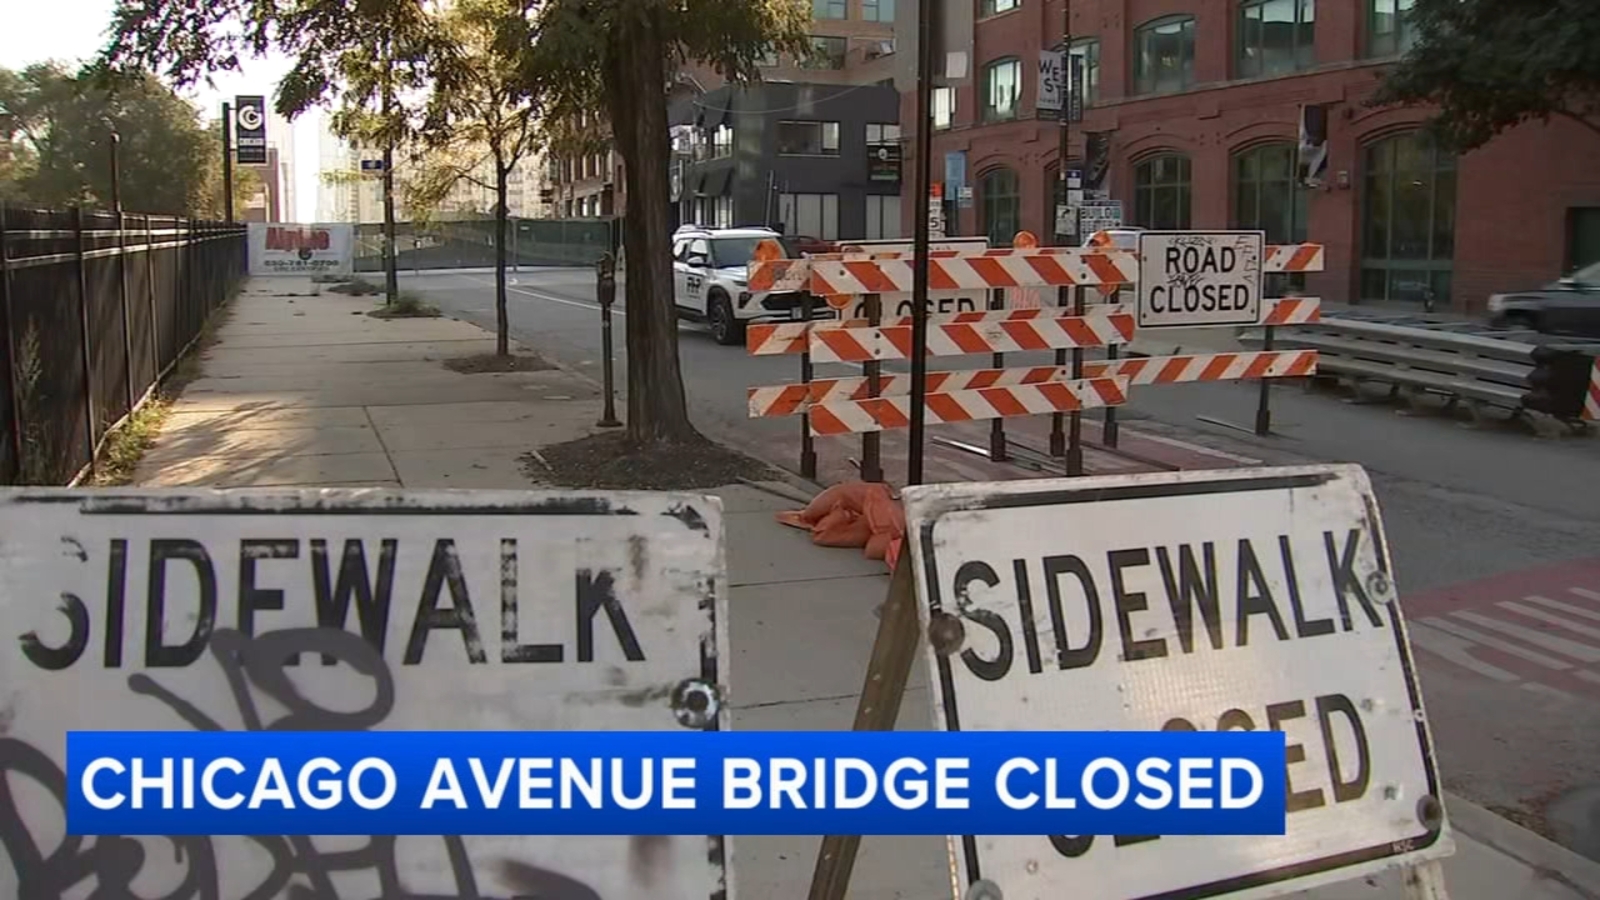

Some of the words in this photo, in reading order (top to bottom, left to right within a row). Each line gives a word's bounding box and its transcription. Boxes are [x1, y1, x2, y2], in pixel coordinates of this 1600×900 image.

[1151, 285, 1249, 313] CLOSED
[1166, 247, 1235, 273] ROAD
[20, 536, 646, 671] SIDEWALK
[953, 529, 1384, 681] SIDEWALK
